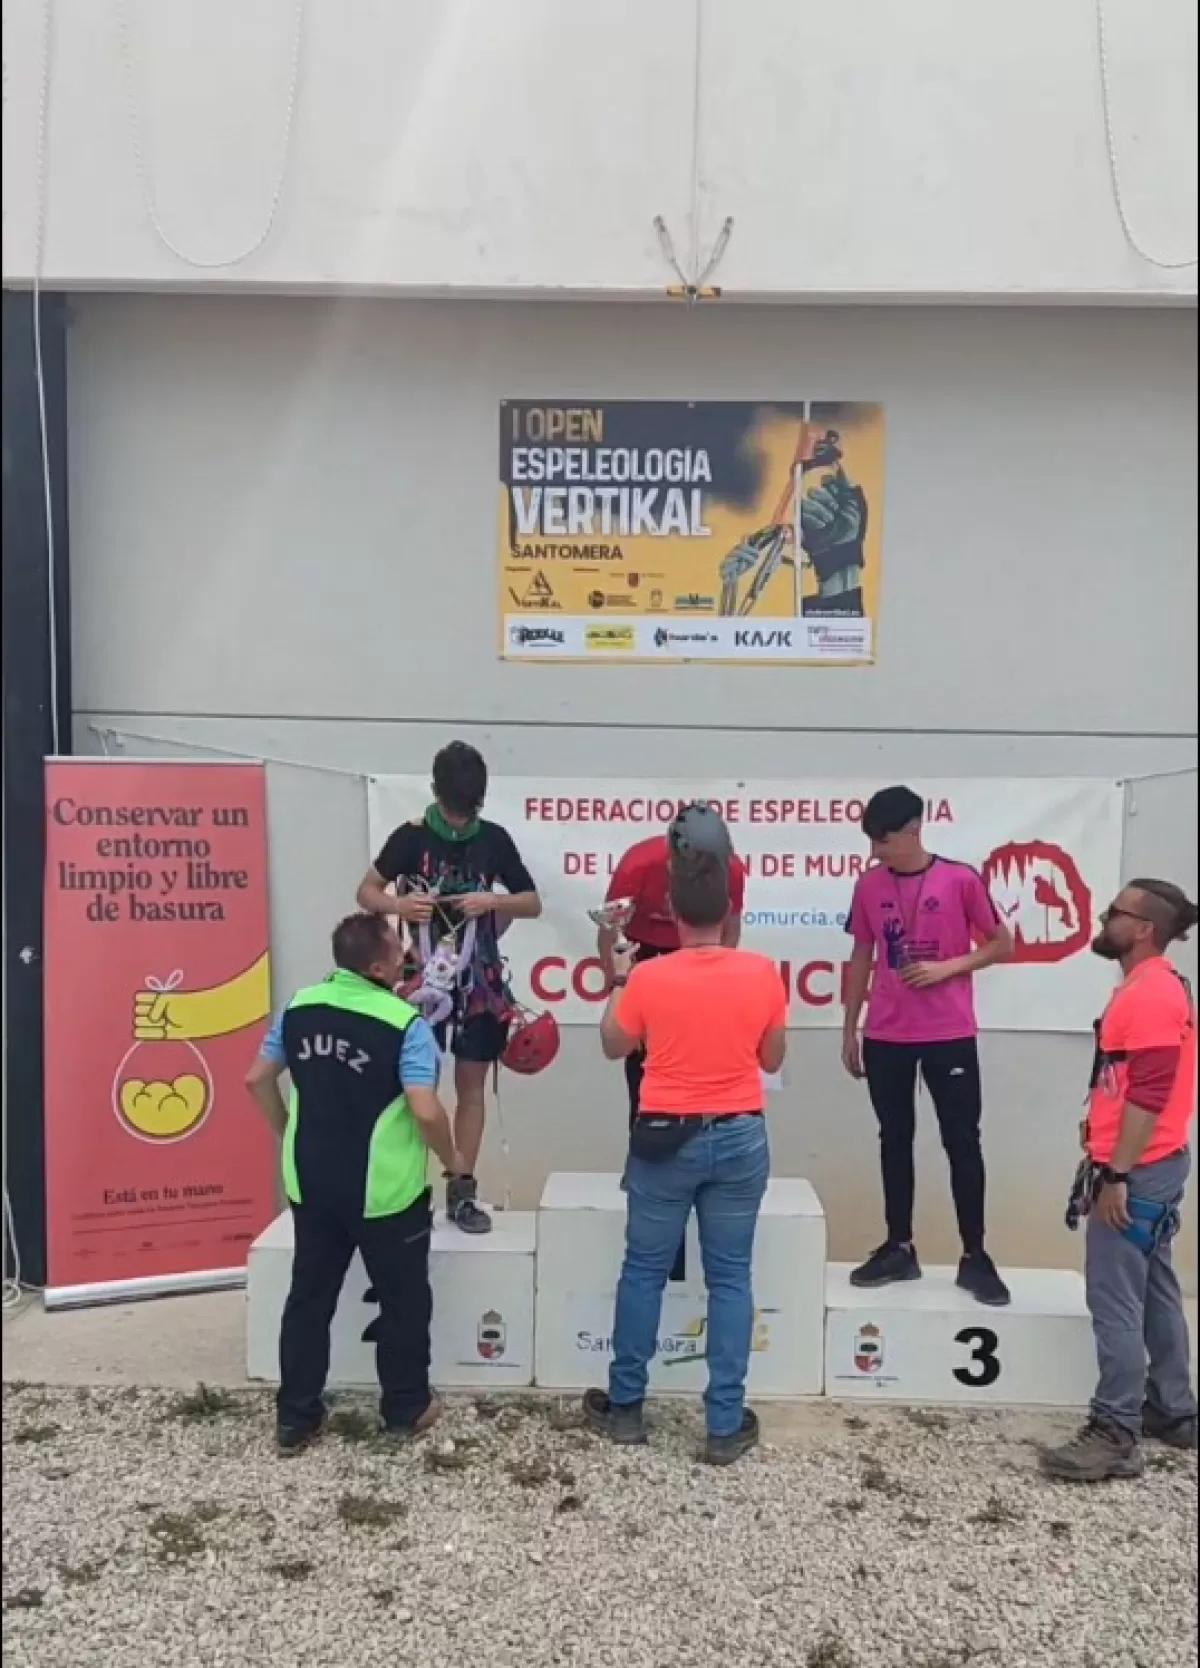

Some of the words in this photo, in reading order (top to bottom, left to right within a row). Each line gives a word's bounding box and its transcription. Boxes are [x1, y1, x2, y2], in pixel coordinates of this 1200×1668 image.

[526, 408, 604, 442] OPEN
[512, 446, 713, 482] ESPELEOLOGÍA
[512, 486, 713, 537] VERTIKAL
[510, 544, 624, 561] SANTOMERA
[734, 630, 793, 647] KASK
[53, 797, 203, 826] Conservar
[212, 806, 249, 826] un
[706, 799, 739, 822] DE
[97, 834, 211, 858] entorno
[58, 861, 152, 894] limpio
[160, 869, 178, 896] y
[187, 862, 249, 890] libre
[564, 852, 597, 875] DE
[762, 854, 795, 877] DE
[86, 894, 120, 922] de
[129, 894, 225, 922] basura
[744, 907, 850, 926] omurcia.e
[297, 1034, 371, 1074] JUEZ
[103, 1187, 137, 1204] Está
[140, 1189, 159, 1201] en
[162, 1185, 179, 1199] tu
[182, 1184, 224, 1198] mano
[952, 1326, 1001, 1388] 3
